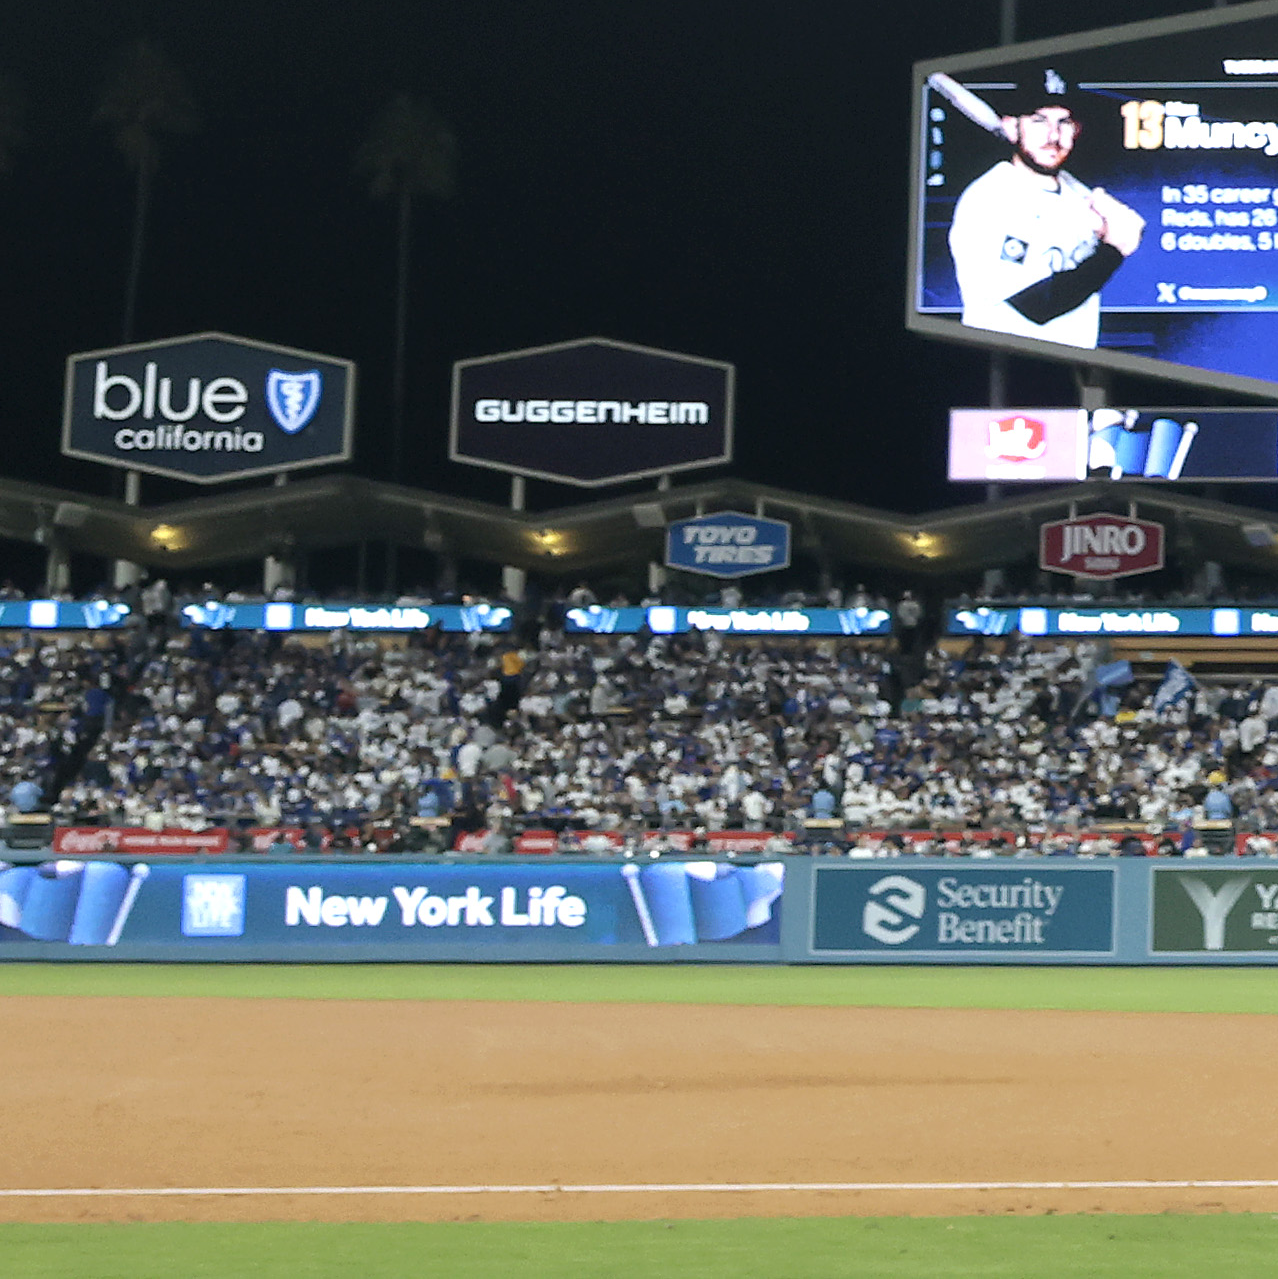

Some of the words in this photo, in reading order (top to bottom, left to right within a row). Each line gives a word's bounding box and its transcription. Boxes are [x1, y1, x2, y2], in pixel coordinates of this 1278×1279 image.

[1121, 100, 1164, 149] 13
[1161, 185, 1181, 204] In
[1210, 187, 1272, 204] career
[1161, 232, 1176, 251] 6
[1258, 231, 1273, 250] 5
[93, 361, 249, 423] blue
[475, 399, 709, 424] GUGGENHEIM
[114, 425, 265, 452] california
[683, 525, 757, 545] TOYO
[1060, 524, 1146, 562] JINRO
[285, 885, 388, 926] New
[393, 885, 496, 926] York
[501, 885, 587, 926] Life
[937, 877, 1064, 915] Security
[937, 912, 1046, 944] Benefit
